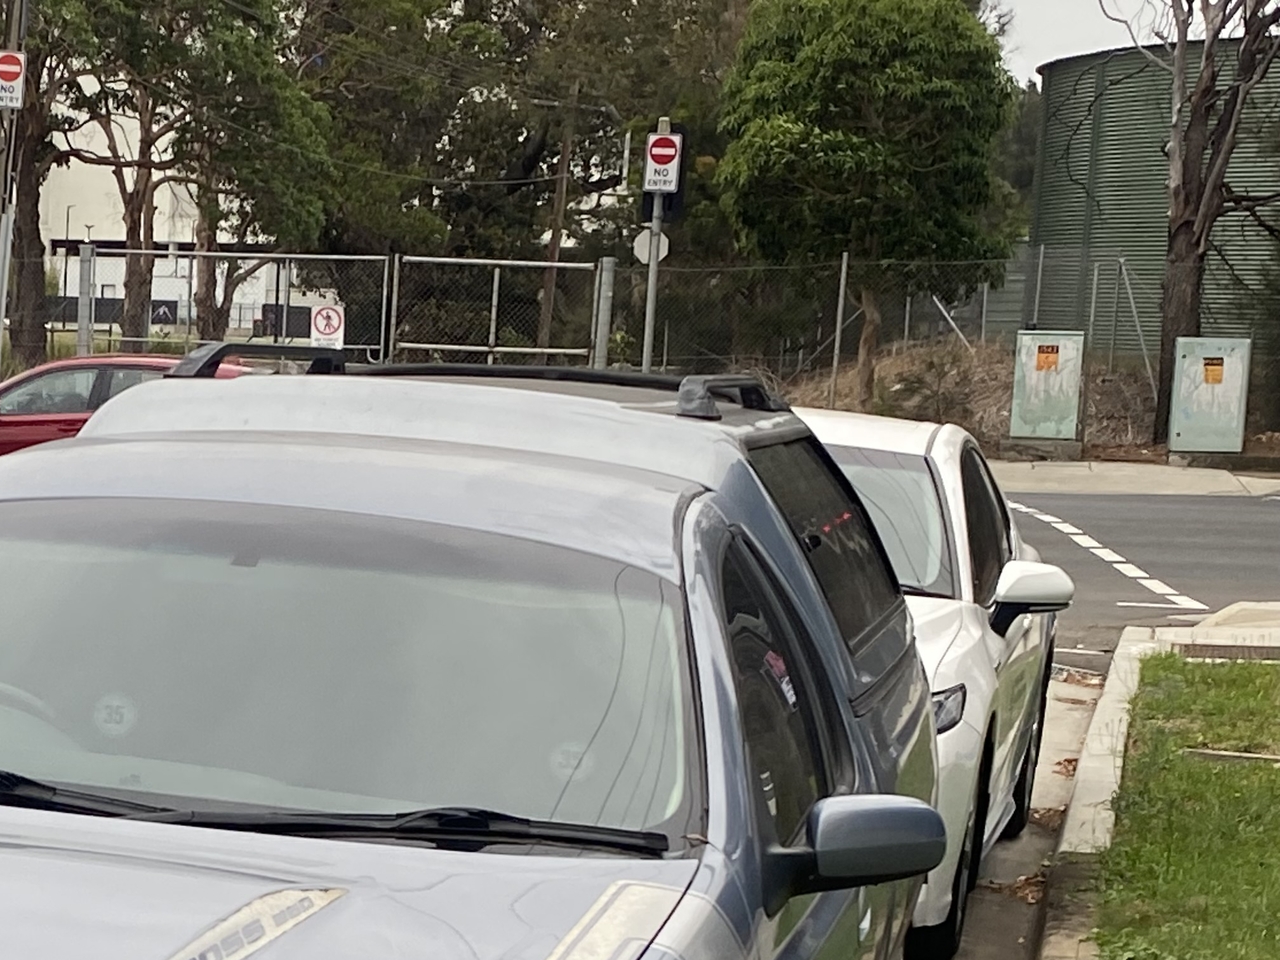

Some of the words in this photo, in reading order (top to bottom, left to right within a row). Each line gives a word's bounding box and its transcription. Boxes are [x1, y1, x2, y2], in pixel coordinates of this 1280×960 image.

[1, 84, 15, 93] NO
[654, 168, 669, 177] NO
[104, 704, 125, 725] 35
